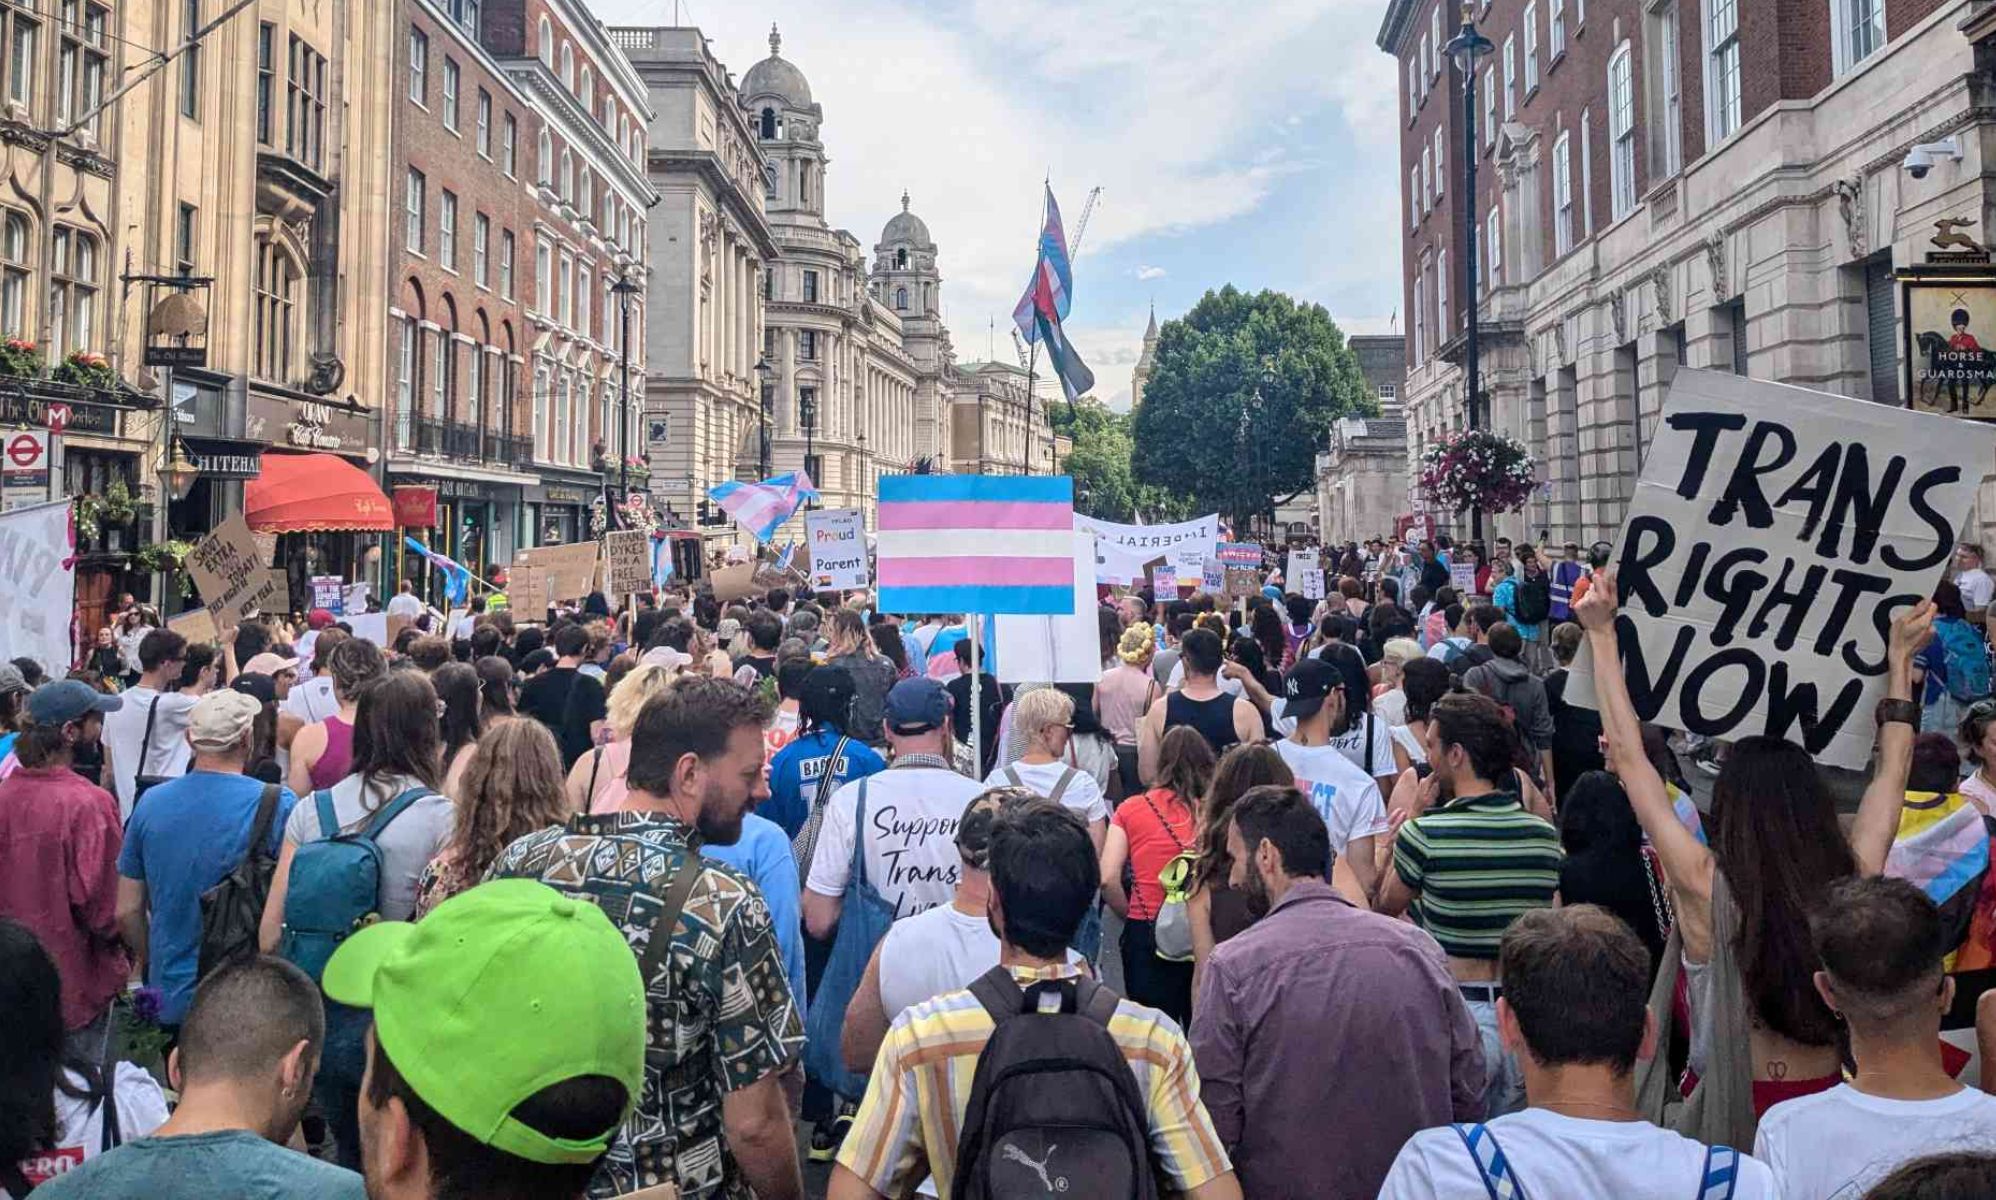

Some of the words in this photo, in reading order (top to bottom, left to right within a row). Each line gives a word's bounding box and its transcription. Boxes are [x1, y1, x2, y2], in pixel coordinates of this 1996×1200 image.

[1938, 351, 1984, 362] HORSE
[1666, 411, 1962, 572] TRANS
[610, 530, 646, 544] TRANS
[816, 527, 855, 542] Proud
[205, 541, 237, 573] EXTRA
[610, 543, 645, 556] DYKES
[632, 555, 641, 565] A
[816, 557, 861, 571] Parent
[612, 567, 638, 580] FREE
[1616, 514, 1928, 677] RIGHTS
[1614, 614, 1864, 755] NOW
[873, 805, 960, 847] Suppor
[881, 849, 960, 887] Trans
